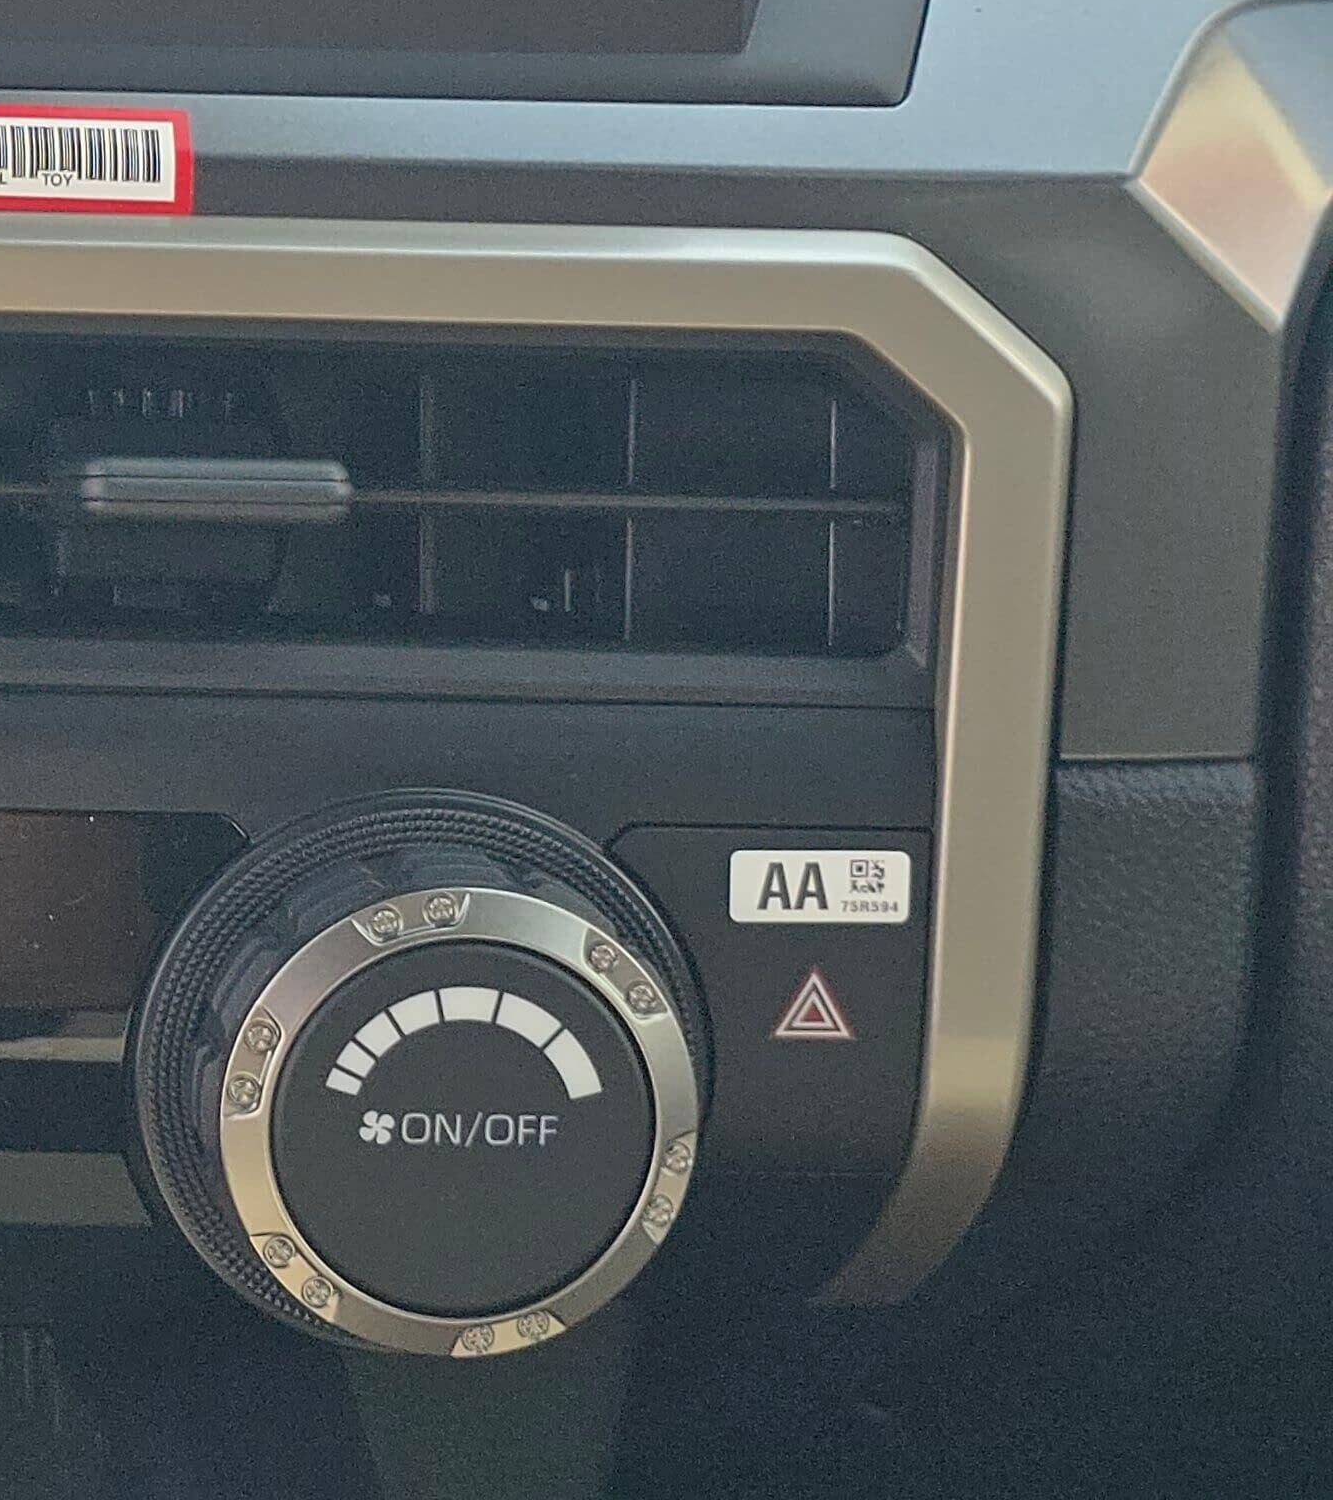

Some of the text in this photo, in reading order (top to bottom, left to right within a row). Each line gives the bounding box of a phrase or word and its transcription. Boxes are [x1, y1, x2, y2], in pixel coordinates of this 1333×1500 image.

[41, 171, 73, 187] TOY
[756, 862, 829, 910] AA
[401, 1113, 557, 1148] ON/OFF
